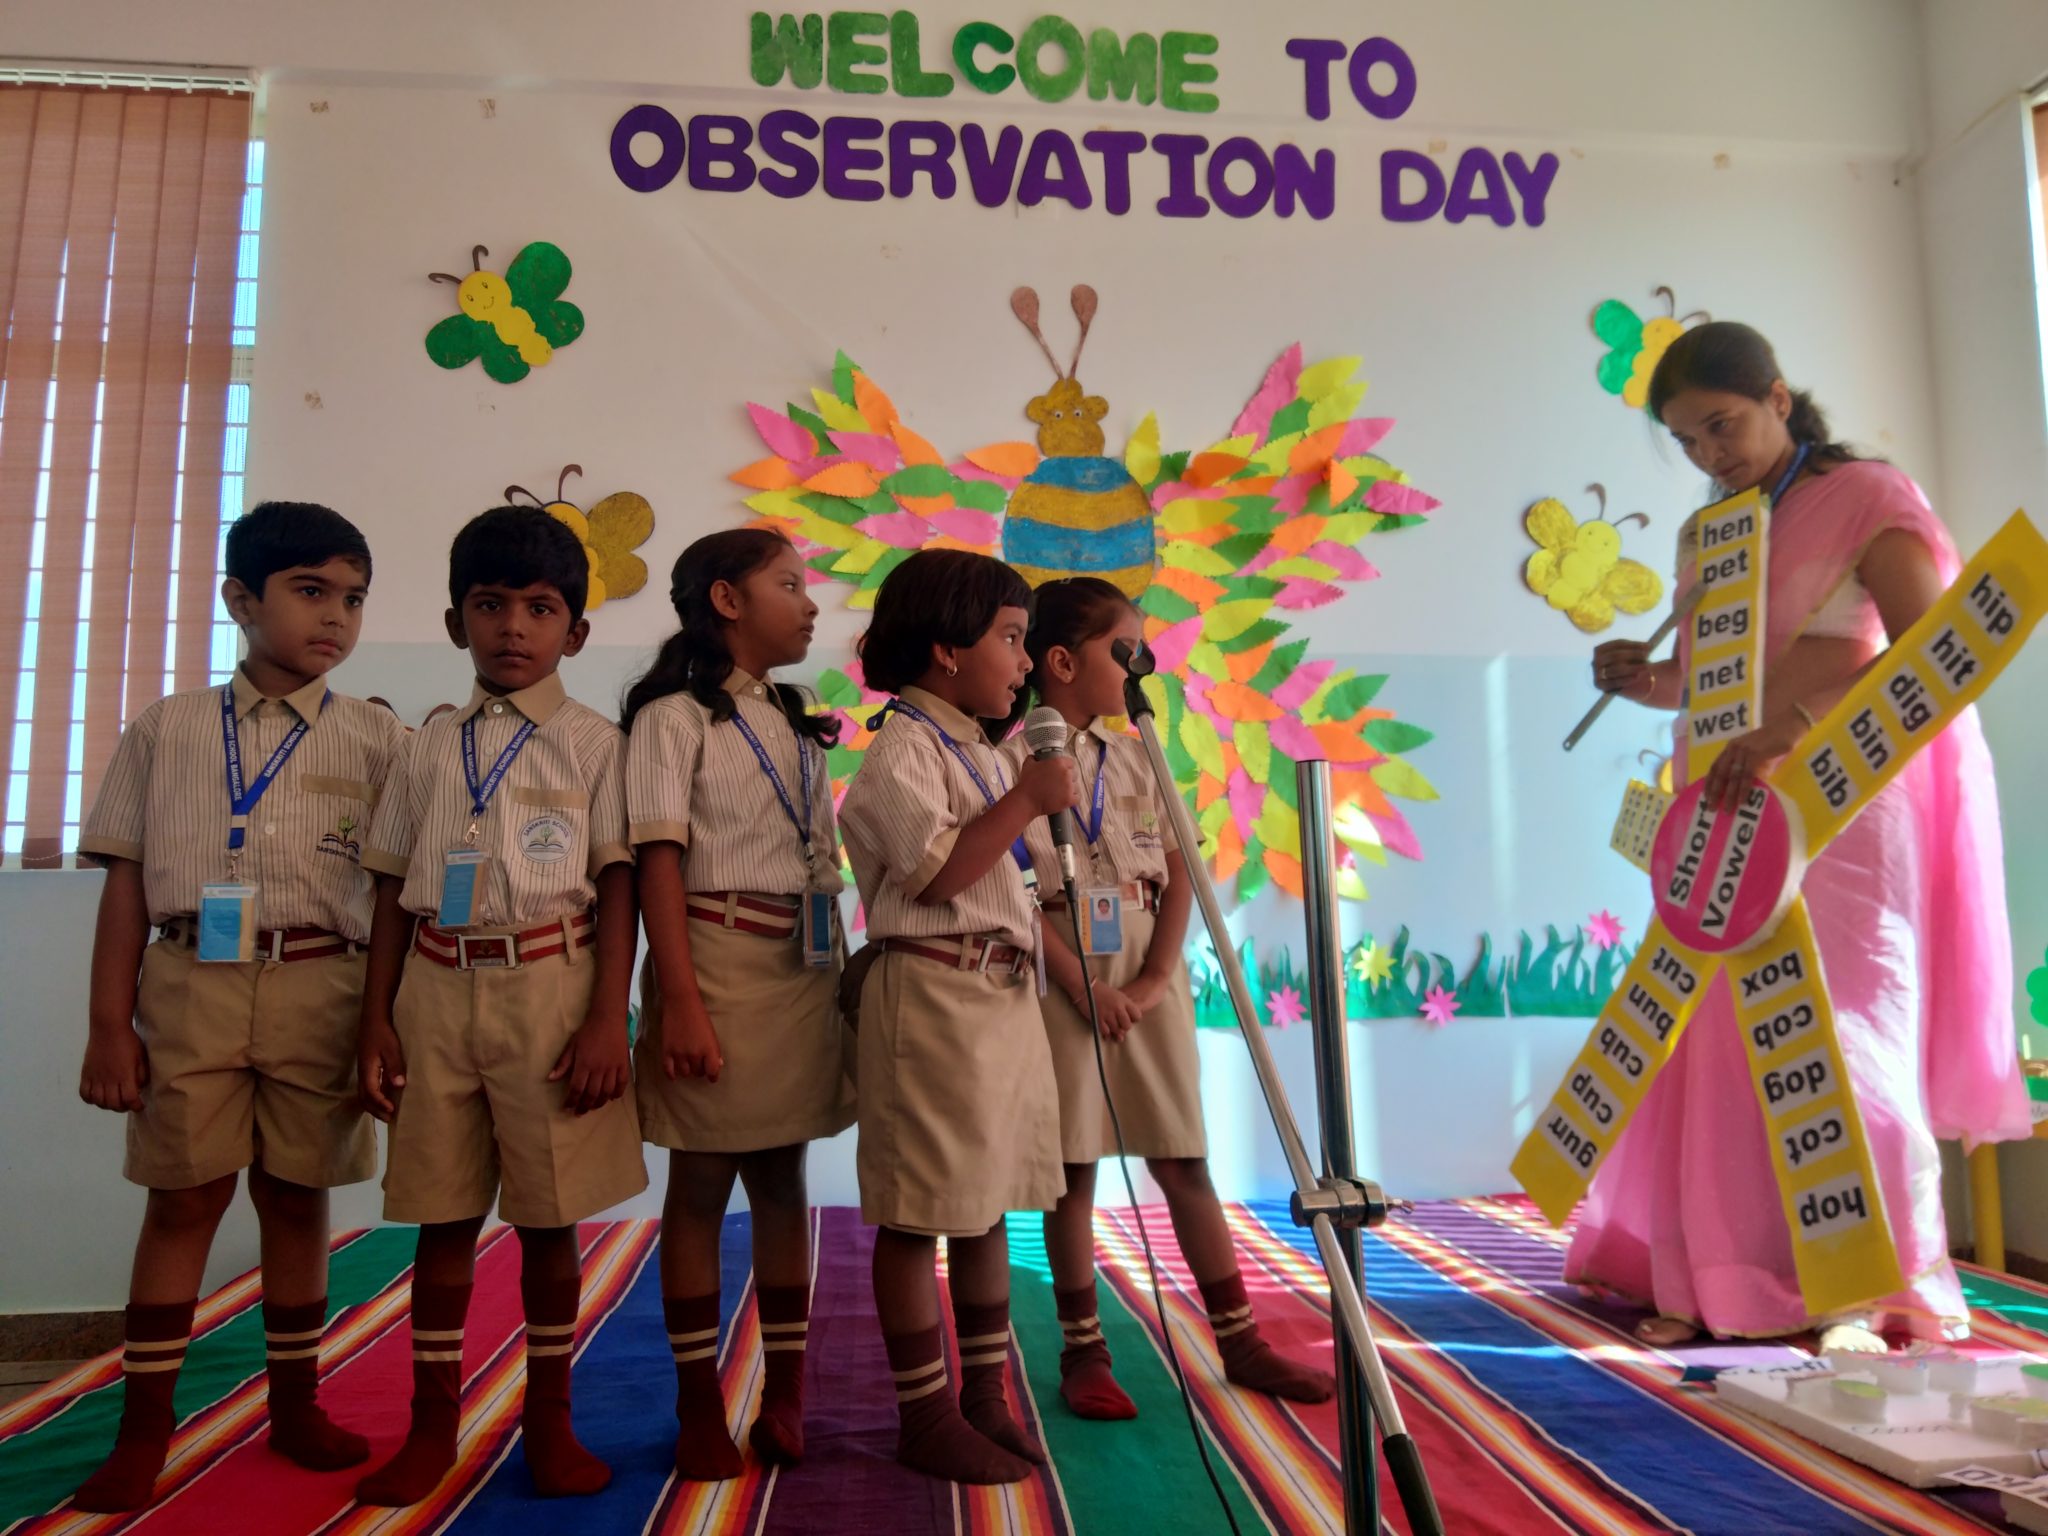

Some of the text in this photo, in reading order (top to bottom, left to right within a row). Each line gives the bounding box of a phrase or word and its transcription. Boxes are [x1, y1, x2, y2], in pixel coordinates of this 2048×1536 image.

[750, 10, 1417, 121] WELCOME TO
[610, 104, 1560, 228] OBSERVATION DAY
[1703, 514, 1754, 548] hen
[1703, 548, 1749, 585] pet
[1696, 606, 1749, 640] beg
[1970, 573, 2014, 636] hip
[1699, 656, 1746, 691] net
[1931, 629, 1976, 686] hit
[1693, 702, 1748, 738] wet
[1889, 674, 1932, 733] dig
[228, 739, 238, 763] SCHOOL
[283, 730, 301, 751] SCHOOL
[511, 722, 534, 750] BANGALOR
[1849, 708, 1889, 771] bin
[231, 763, 243, 801] BANGALORE
[1810, 748, 1848, 809] bib
[1701, 789, 1766, 929] Vowels
[1652, 948, 1696, 994] cut
[1741, 952, 1803, 998] box
[1628, 983, 1675, 1042] bun
[1752, 1004, 1813, 1050] cob
[1600, 1027, 1643, 1077] cub
[1572, 1073, 1613, 1125] cup
[1762, 1061, 1826, 1103] dog
[1548, 1116, 1598, 1169] gum
[1786, 1119, 1842, 1165] cot
[1800, 1186, 1867, 1227] hop
